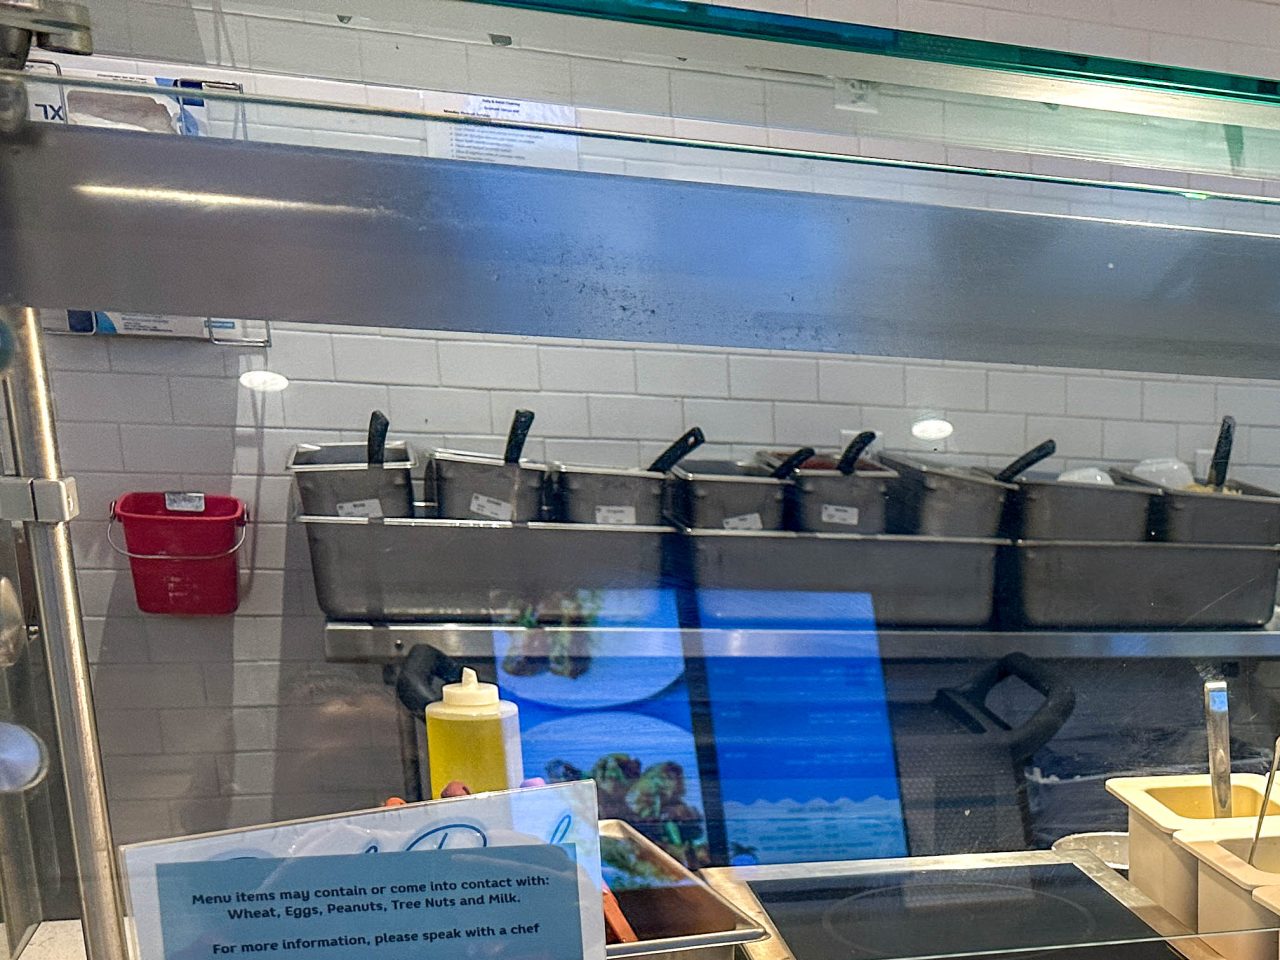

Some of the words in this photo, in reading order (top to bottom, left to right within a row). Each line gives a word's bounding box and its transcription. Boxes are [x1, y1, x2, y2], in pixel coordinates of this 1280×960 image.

[192, 890, 232, 905] Menu
[236, 887, 276, 902] items
[279, 885, 310, 902] may
[314, 884, 367, 898] contain
[371, 886, 387, 895] or
[390, 882, 426, 894] come
[430, 879, 457, 891] into
[461, 875, 512, 889] contact
[516, 874, 550, 887] with:
[227, 905, 282, 920] Wheat,
[285, 903, 324, 919] Eggs,
[327, 900, 388, 915] Peanuts,
[390, 898, 421, 910] Tree
[425, 896, 456, 908] Nuts
[460, 893, 485, 905] and
[488, 892, 521, 905] Milk.
[212, 942, 238, 954] For
[241, 940, 279, 952] more
[282, 934, 371, 950] information,
[375, 930, 418, 945] please
[422, 928, 461, 942] speak
[465, 925, 496, 938] with
[499, 927, 507, 936] a
[510, 922, 541, 934] chef
